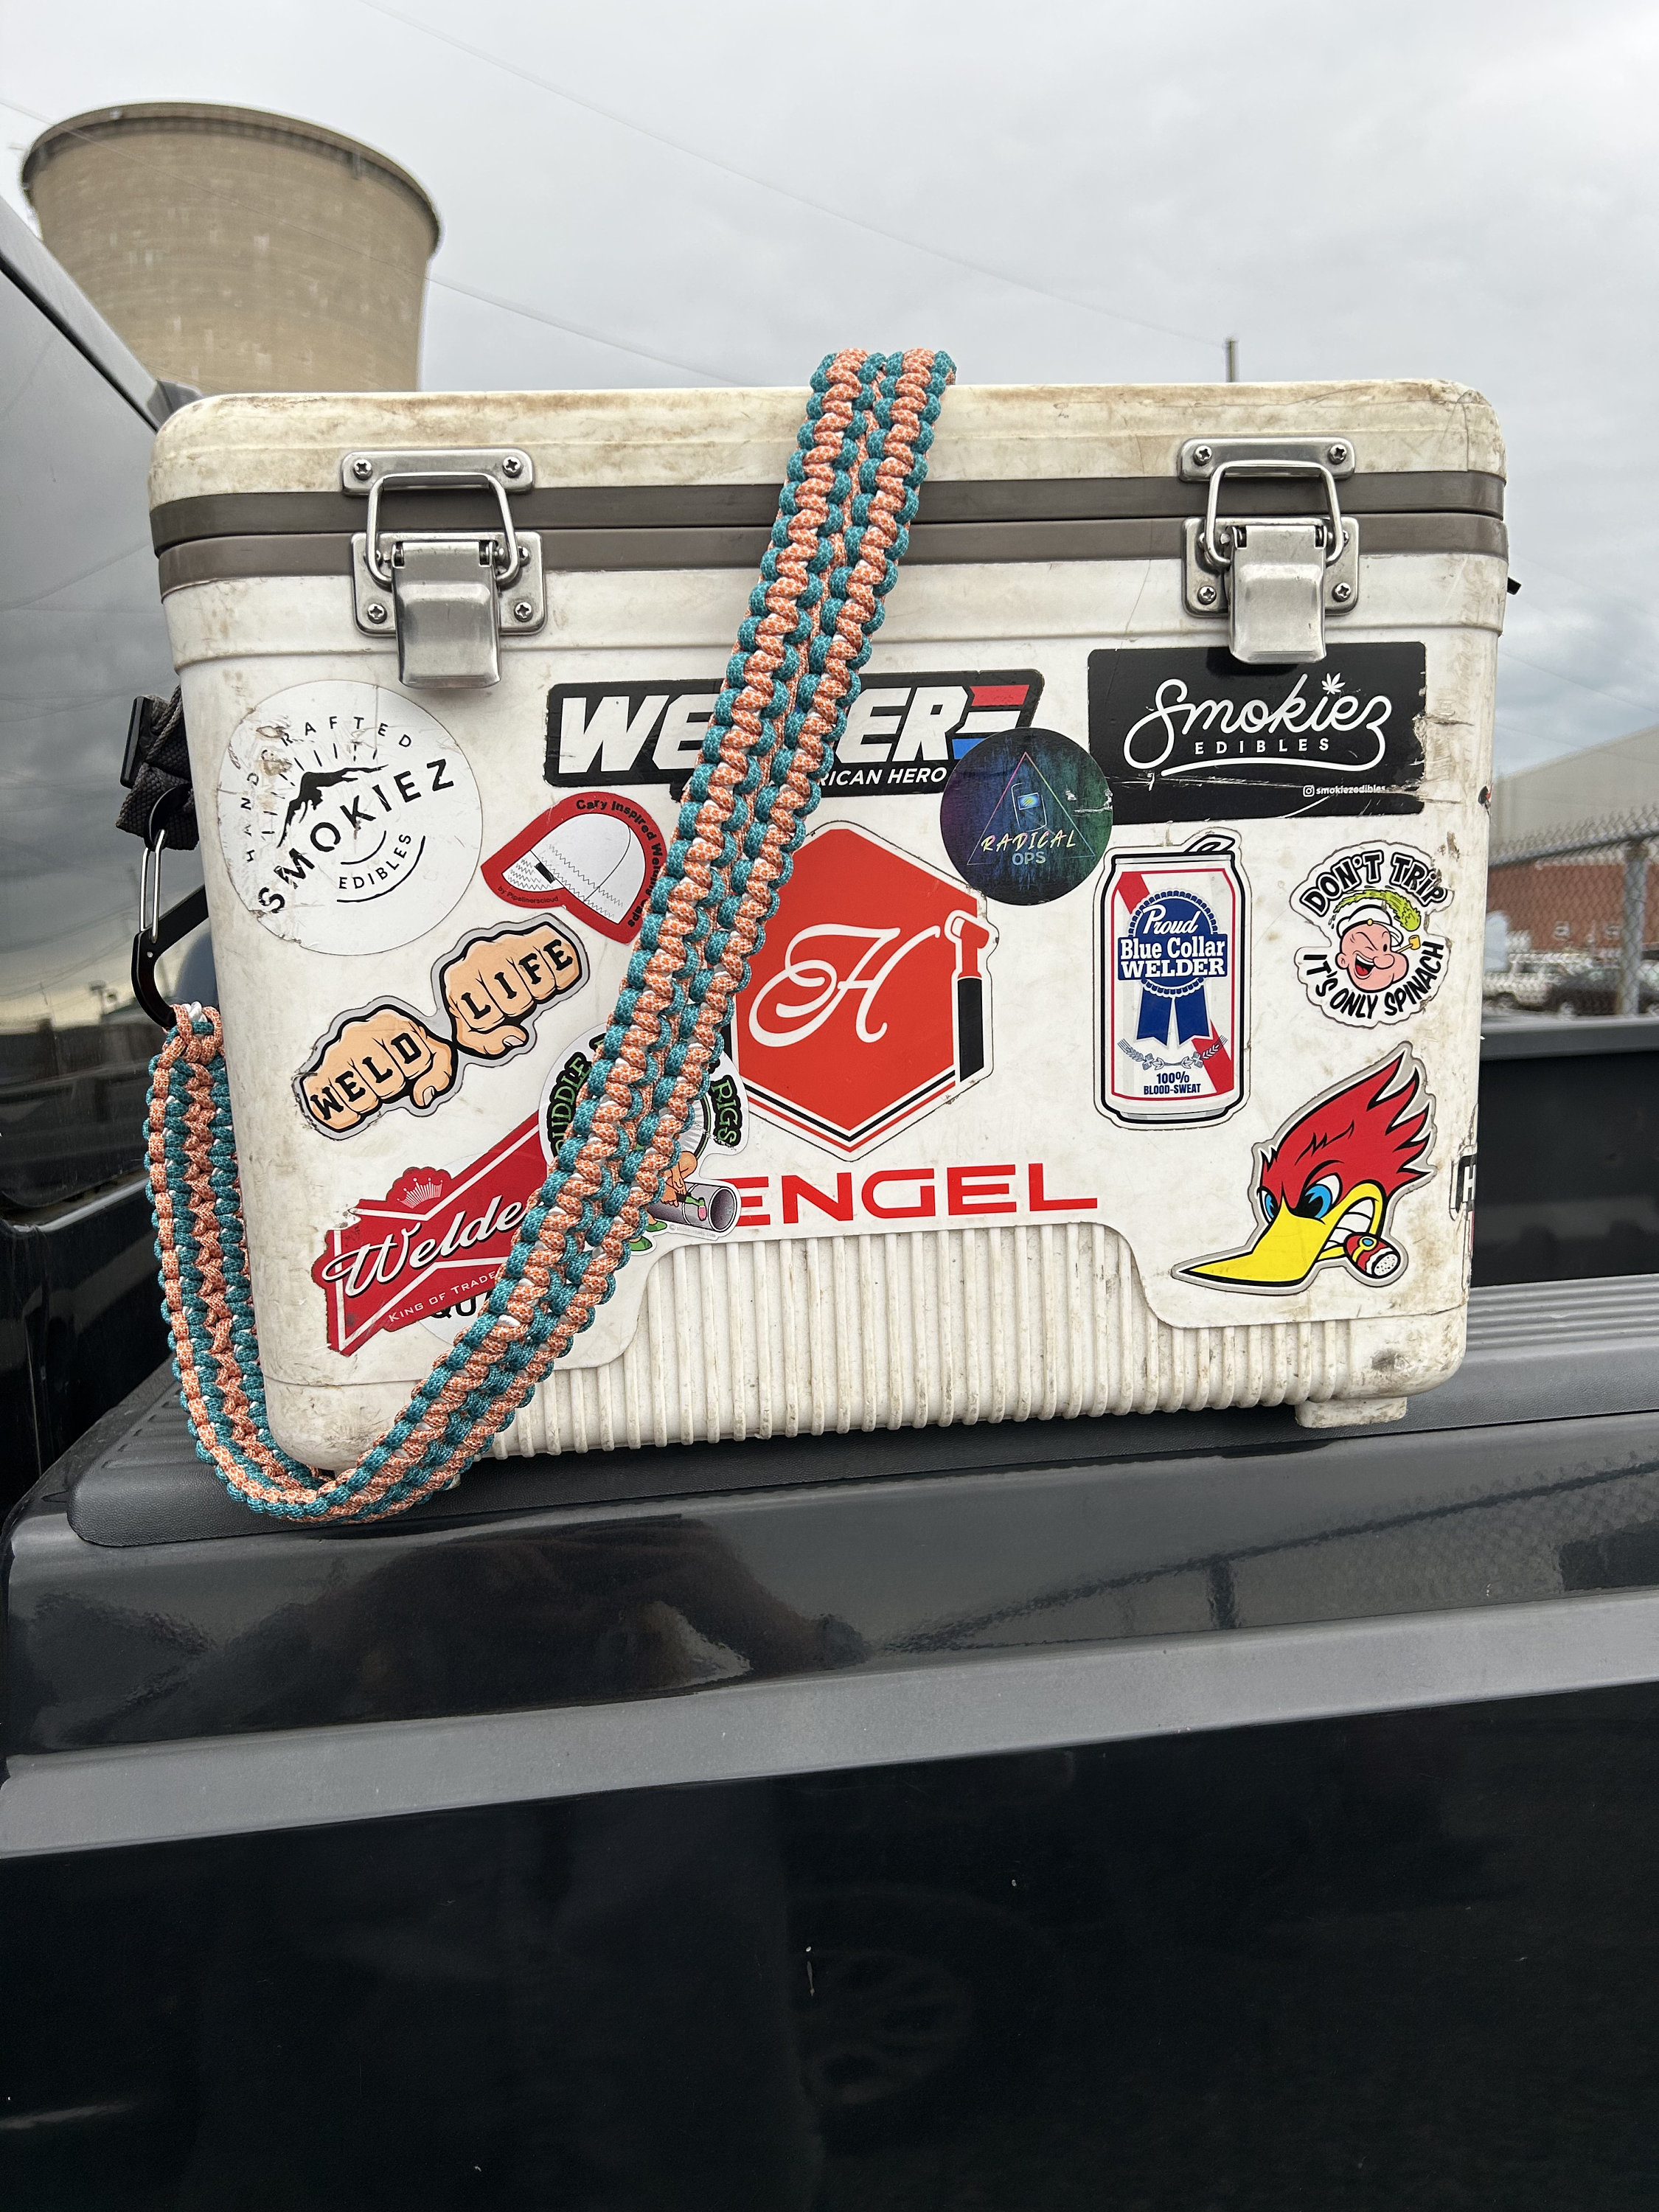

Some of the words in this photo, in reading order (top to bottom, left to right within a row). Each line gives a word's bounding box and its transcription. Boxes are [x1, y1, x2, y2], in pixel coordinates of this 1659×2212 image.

[558, 686, 969, 774] WEER
[1194, 737, 1330, 755] EDIBLES
[819, 769, 883, 786] RICAN
[887, 768, 947, 785] HERO
[257, 759, 454, 914] SMOKIEZ
[576, 799, 608, 810] Cary
[611, 801, 658, 841] Inspired
[981, 829, 1077, 852] RADICAL
[339, 833, 411, 889] EDIBLES
[1012, 851, 1046, 866] OPS
[497, 886, 507, 894] by
[1300, 850, 1384, 917] DON'T
[1142, 904, 1202, 935] Proud
[1120, 938, 1163, 959] Blue
[1166, 936, 1225, 959] Collar
[1120, 958, 1225, 979] WELDER
[461, 939, 574, 1020] LIFE
[1303, 954, 1338, 997] IT'S
[1329, 988, 1379, 1019] ONLY
[1384, 941, 1444, 1016] SPINACH
[310, 1032, 422, 1121] WELD
[1144, 1083, 1201, 1095] BLOOD-SWEAT
[1156, 1071, 1190, 1085] 100%
[710, 1079, 738, 1144] RIGS
[321, 1194, 526, 1297] Welde
[388, 1302, 424, 1322] KING
[428, 1292, 446, 1305] OF
[451, 1270, 496, 1295] TRADE
